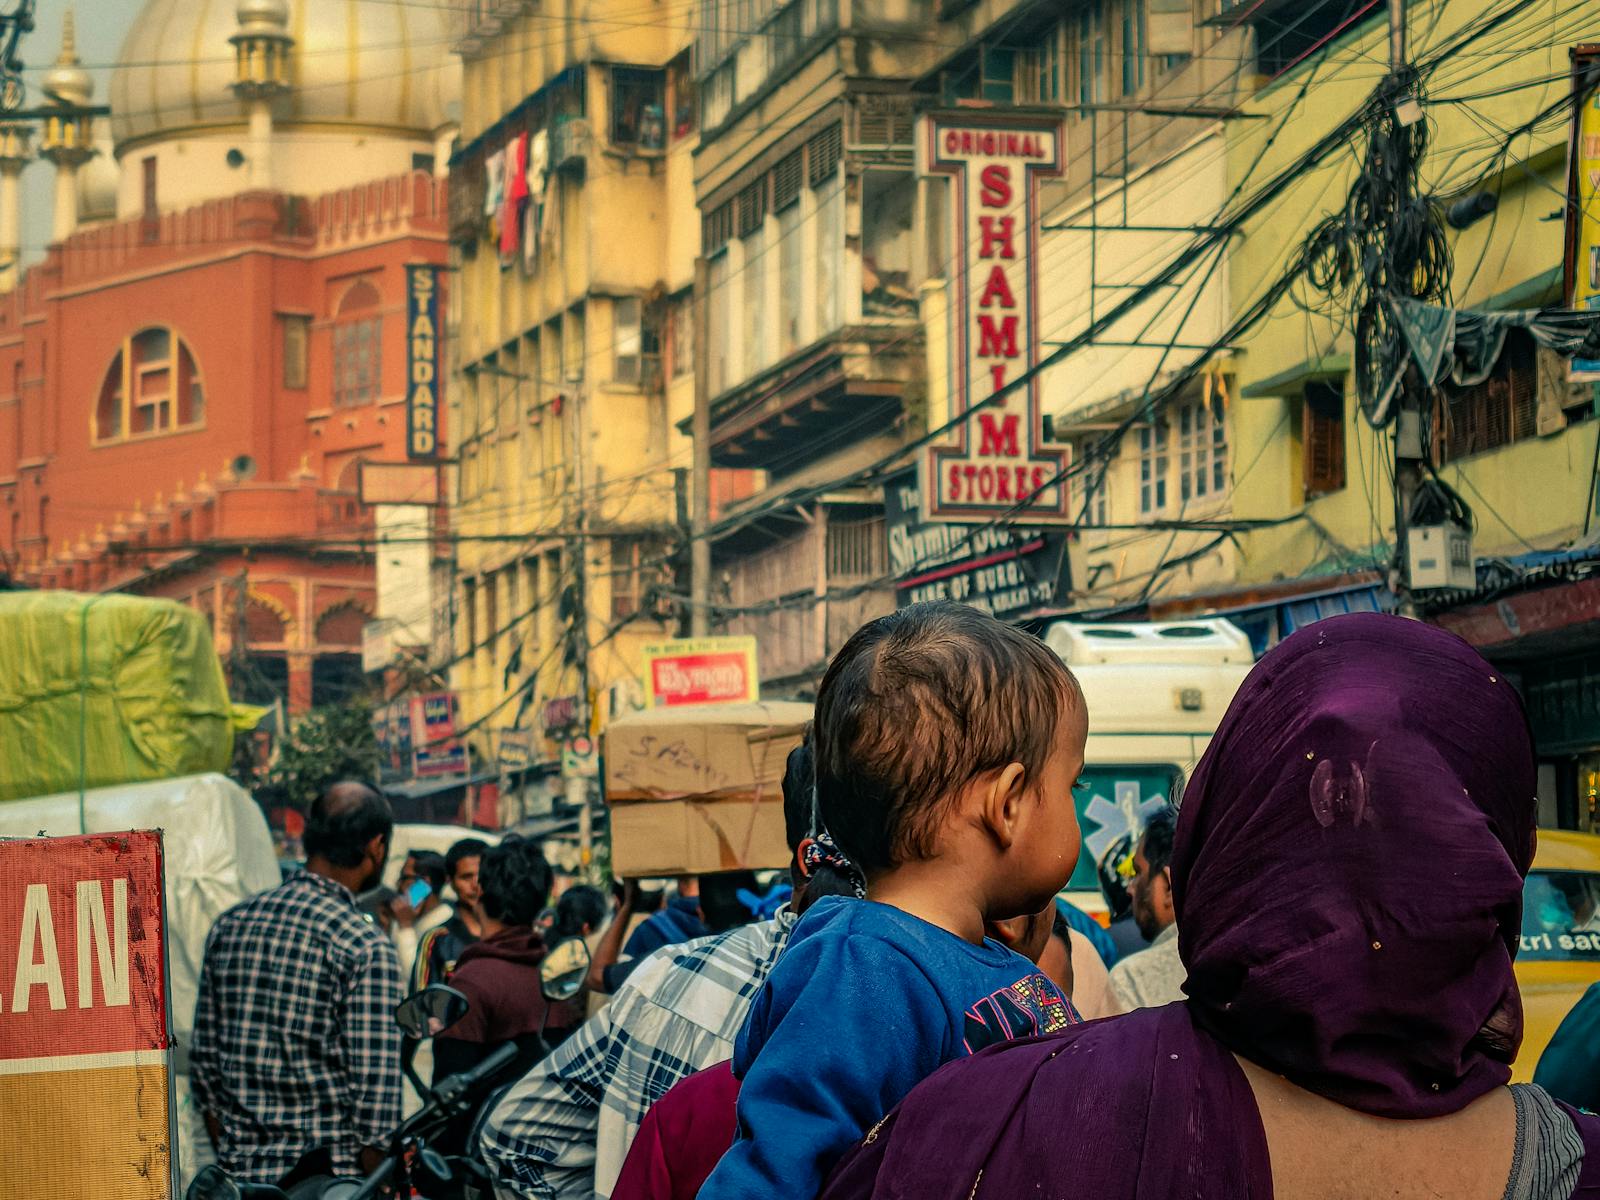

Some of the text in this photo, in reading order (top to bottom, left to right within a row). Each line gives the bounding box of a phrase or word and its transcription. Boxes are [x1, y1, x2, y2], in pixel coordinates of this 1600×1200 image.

[945, 130, 1045, 158] ORIGINAL
[977, 165, 1020, 457] SHAMIM
[412, 269, 434, 454] STANDARD
[949, 465, 1045, 501] STORES
[0, 878, 130, 1014] AN
[1515, 932, 1552, 951] tri
